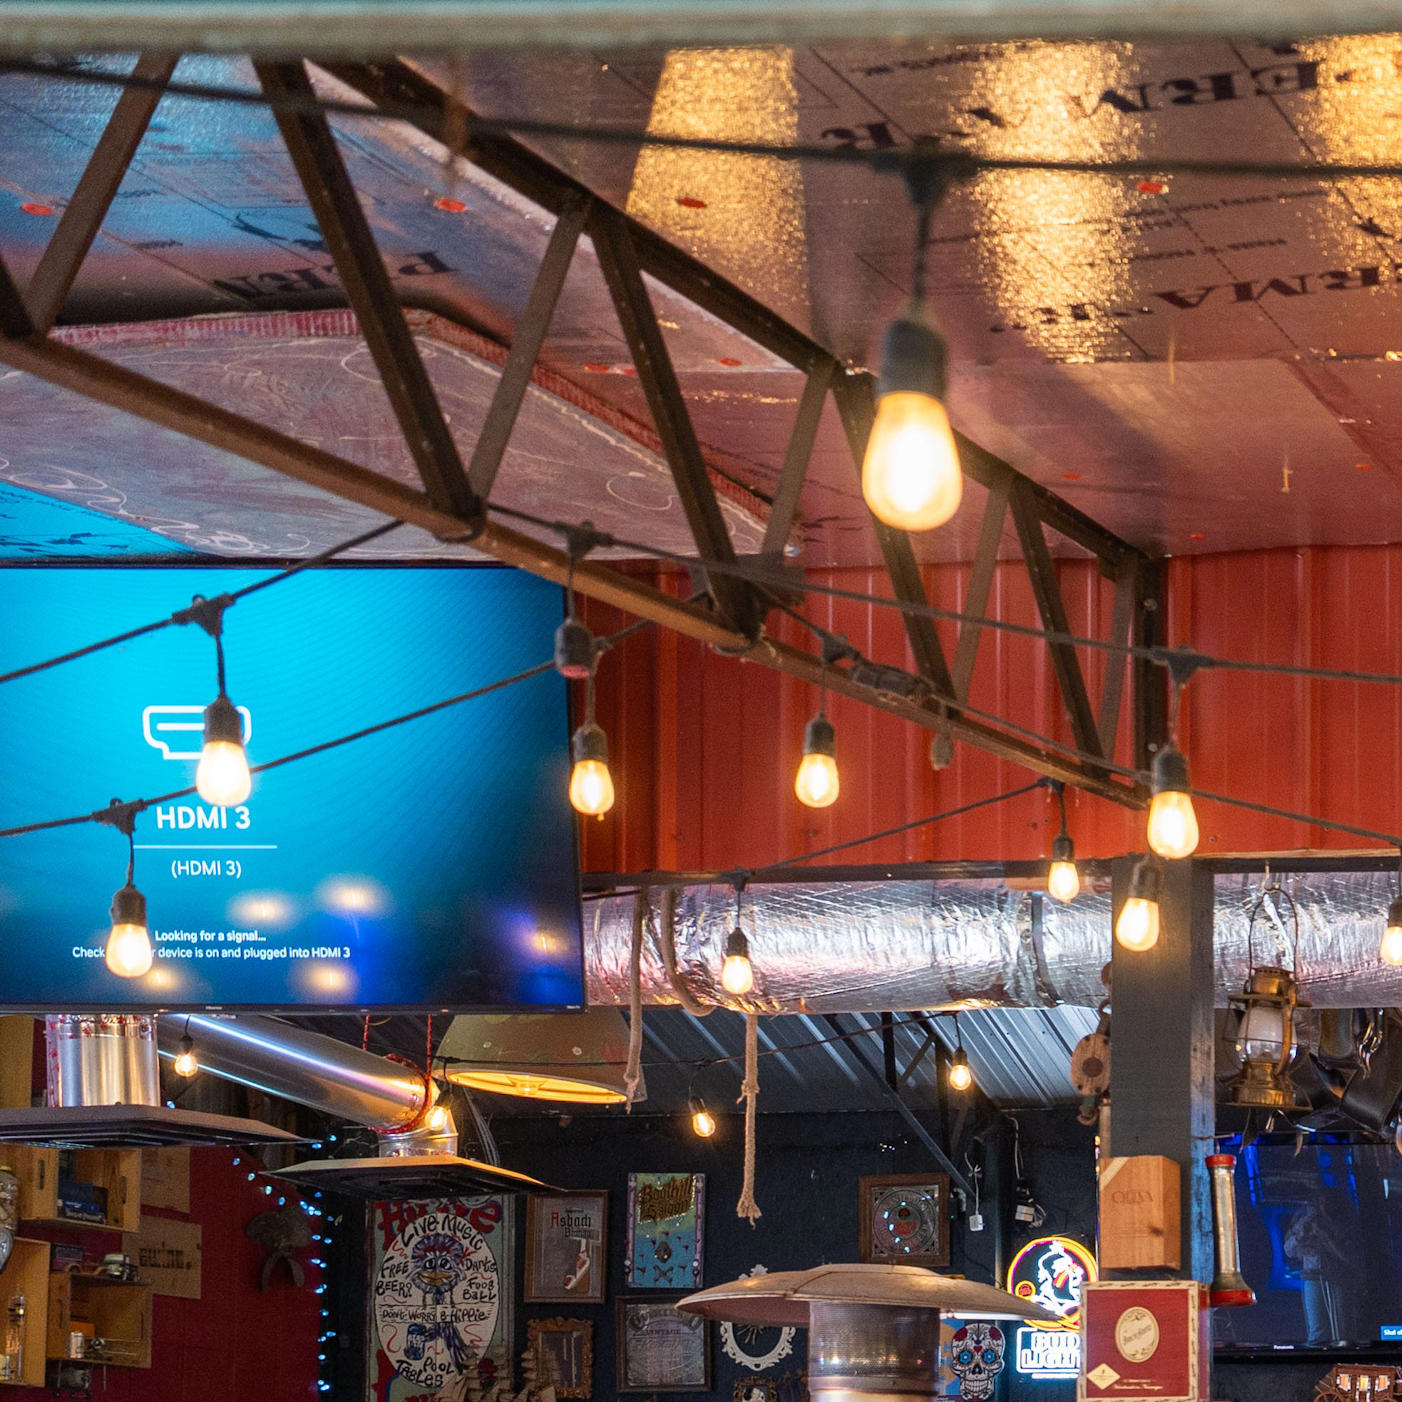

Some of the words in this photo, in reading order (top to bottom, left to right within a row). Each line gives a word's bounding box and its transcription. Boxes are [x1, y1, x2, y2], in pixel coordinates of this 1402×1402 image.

[157, 806, 228, 829] HDMI
[235, 806, 251, 829] 3
[171, 860, 221, 879] (HDMI
[226, 860, 242, 878] 3)
[154, 930, 198, 942] Looking
[200, 930, 215, 941] for
[218, 933, 224, 941] a
[227, 930, 267, 943] signal...
[72, 947, 105, 958] Check
[158, 947, 191, 958] device
[195, 947, 204, 958] is
[206, 949, 219, 958] on
[221, 947, 241, 958] and
[243, 947, 286, 960] plugged
[289, 947, 309, 958] into
[312, 947, 342, 958] HDMI
[344, 947, 350, 958] 3
